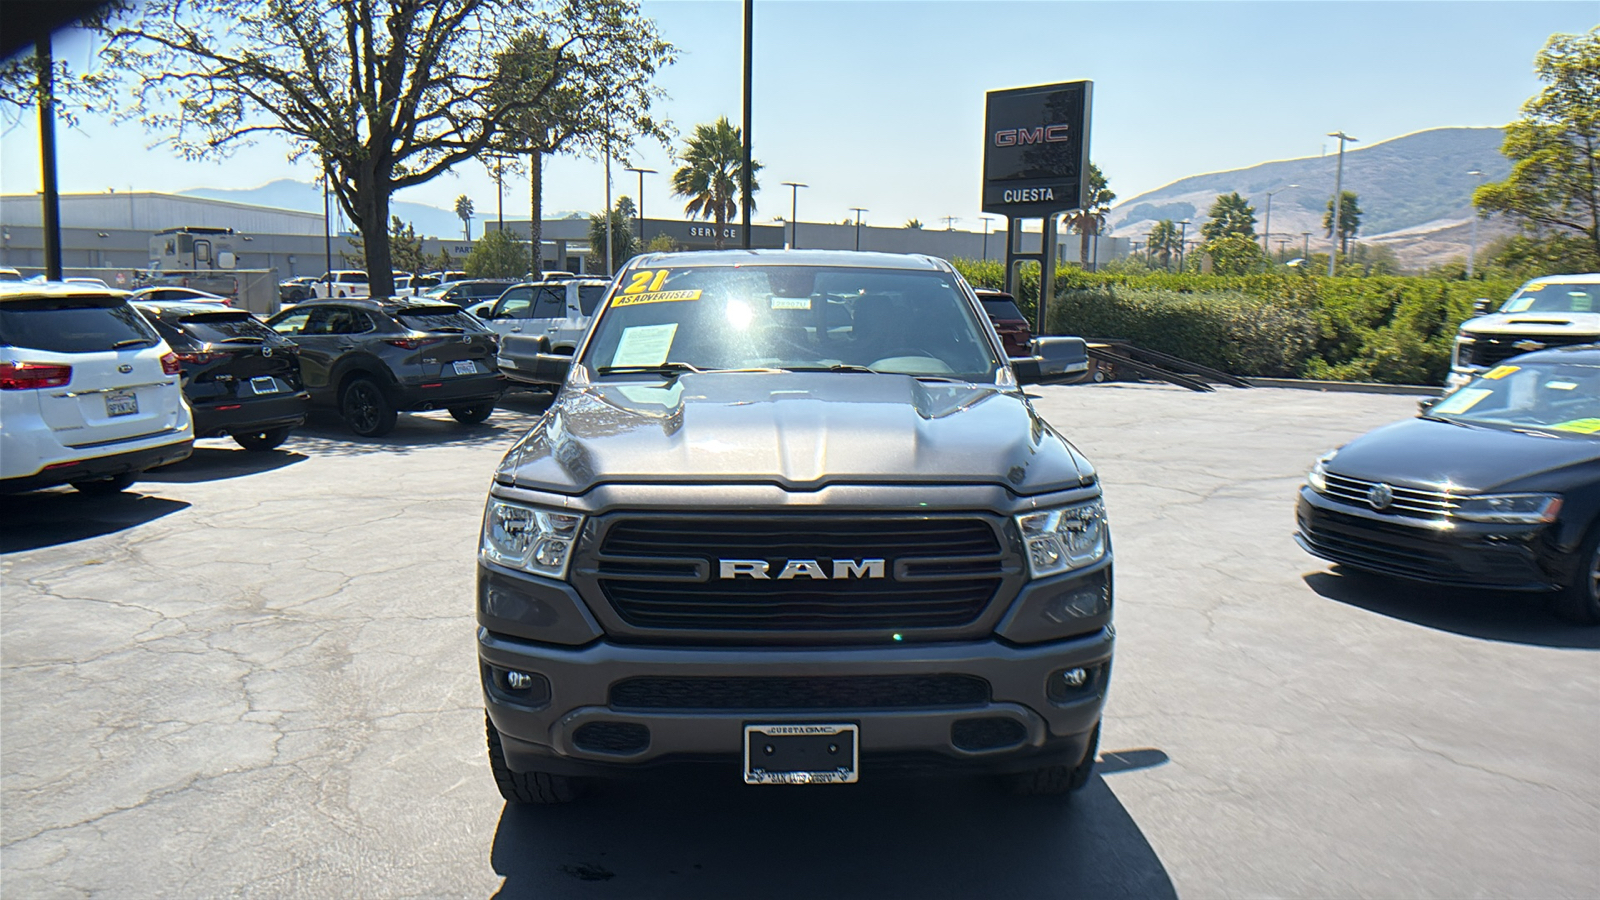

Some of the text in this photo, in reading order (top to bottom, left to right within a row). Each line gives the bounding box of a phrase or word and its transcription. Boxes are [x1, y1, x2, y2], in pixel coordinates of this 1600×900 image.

[996, 125, 1068, 146] GMC
[1004, 188, 1054, 203] CUESTA
[690, 227, 736, 238] SERVCE
[624, 269, 670, 294] 21
[617, 290, 694, 305] AS ADVERTISED
[719, 559, 885, 579] RAM
